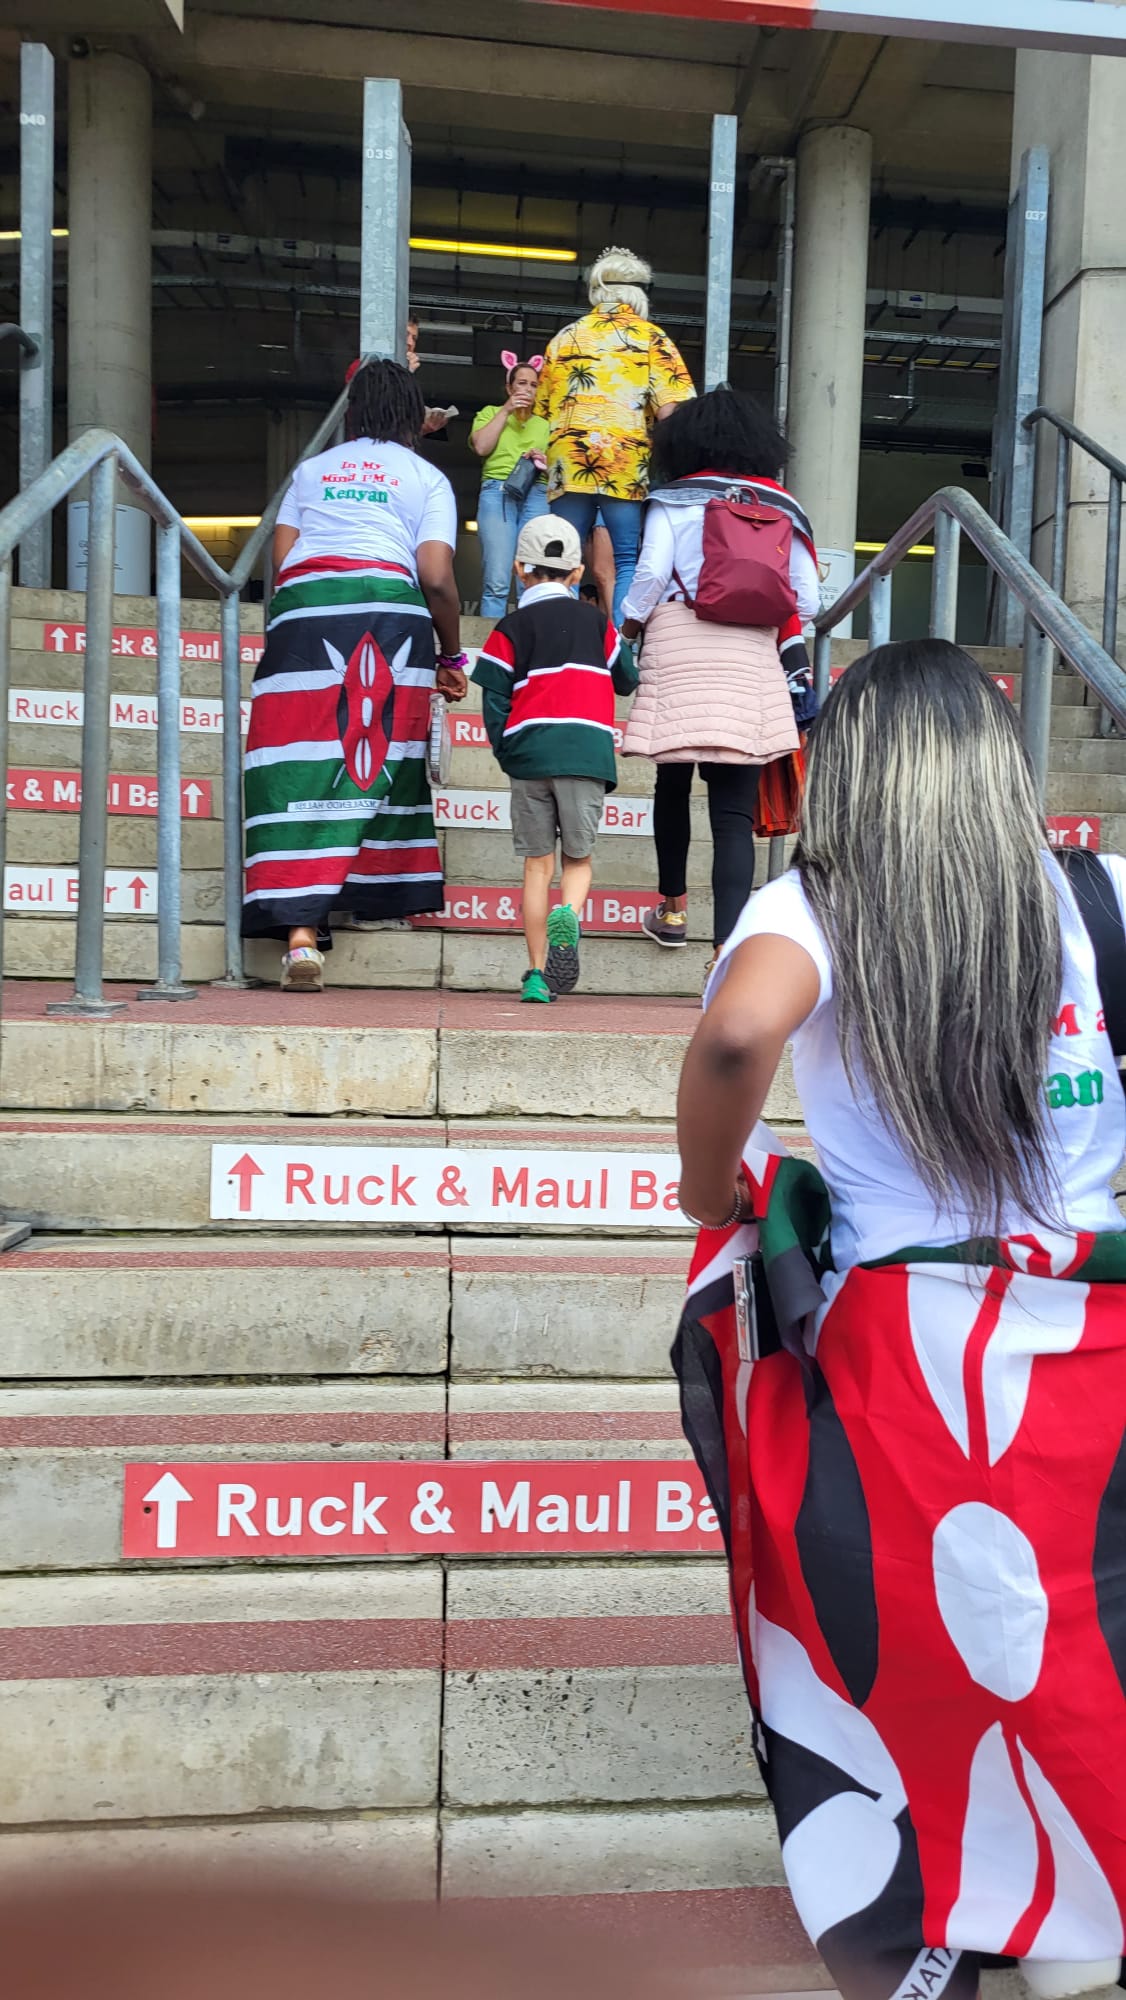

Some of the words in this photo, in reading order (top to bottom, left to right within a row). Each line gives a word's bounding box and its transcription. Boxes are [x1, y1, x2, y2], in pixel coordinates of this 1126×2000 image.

[366, 148, 393, 160] 039
[1025, 210, 1047, 221] 037
[321, 473, 356, 483] Mind
[322, 486, 389, 503] Kenyan
[75, 631, 135, 656] Rck
[140, 636, 158, 656] &
[178, 639, 220, 660] aul
[15, 697, 80, 721] Ruck
[183, 706, 224, 727] Bar
[455, 721, 487, 742] Ru
[23, 778, 44, 802] &
[129, 784, 159, 808] Ba
[435, 798, 501, 822] Ruck
[605, 805, 648, 828] Bar
[1046, 828, 1071, 846] ar
[8, 878, 54, 902] aul
[66, 879, 118, 904] Br
[413, 895, 489, 920] uck
[496, 896, 517, 921] &
[603, 900, 652, 924] Bar
[286, 1163, 418, 1207] Ruck
[436, 1165, 472, 1207] &
[492, 1167, 608, 1210] Maul
[630, 1170, 682, 1211] Ba
[217, 1482, 389, 1538] Ruck
[410, 1482, 456, 1535] &
[480, 1481, 631, 1534] Maul
[656, 1480, 721, 1533] Ba
